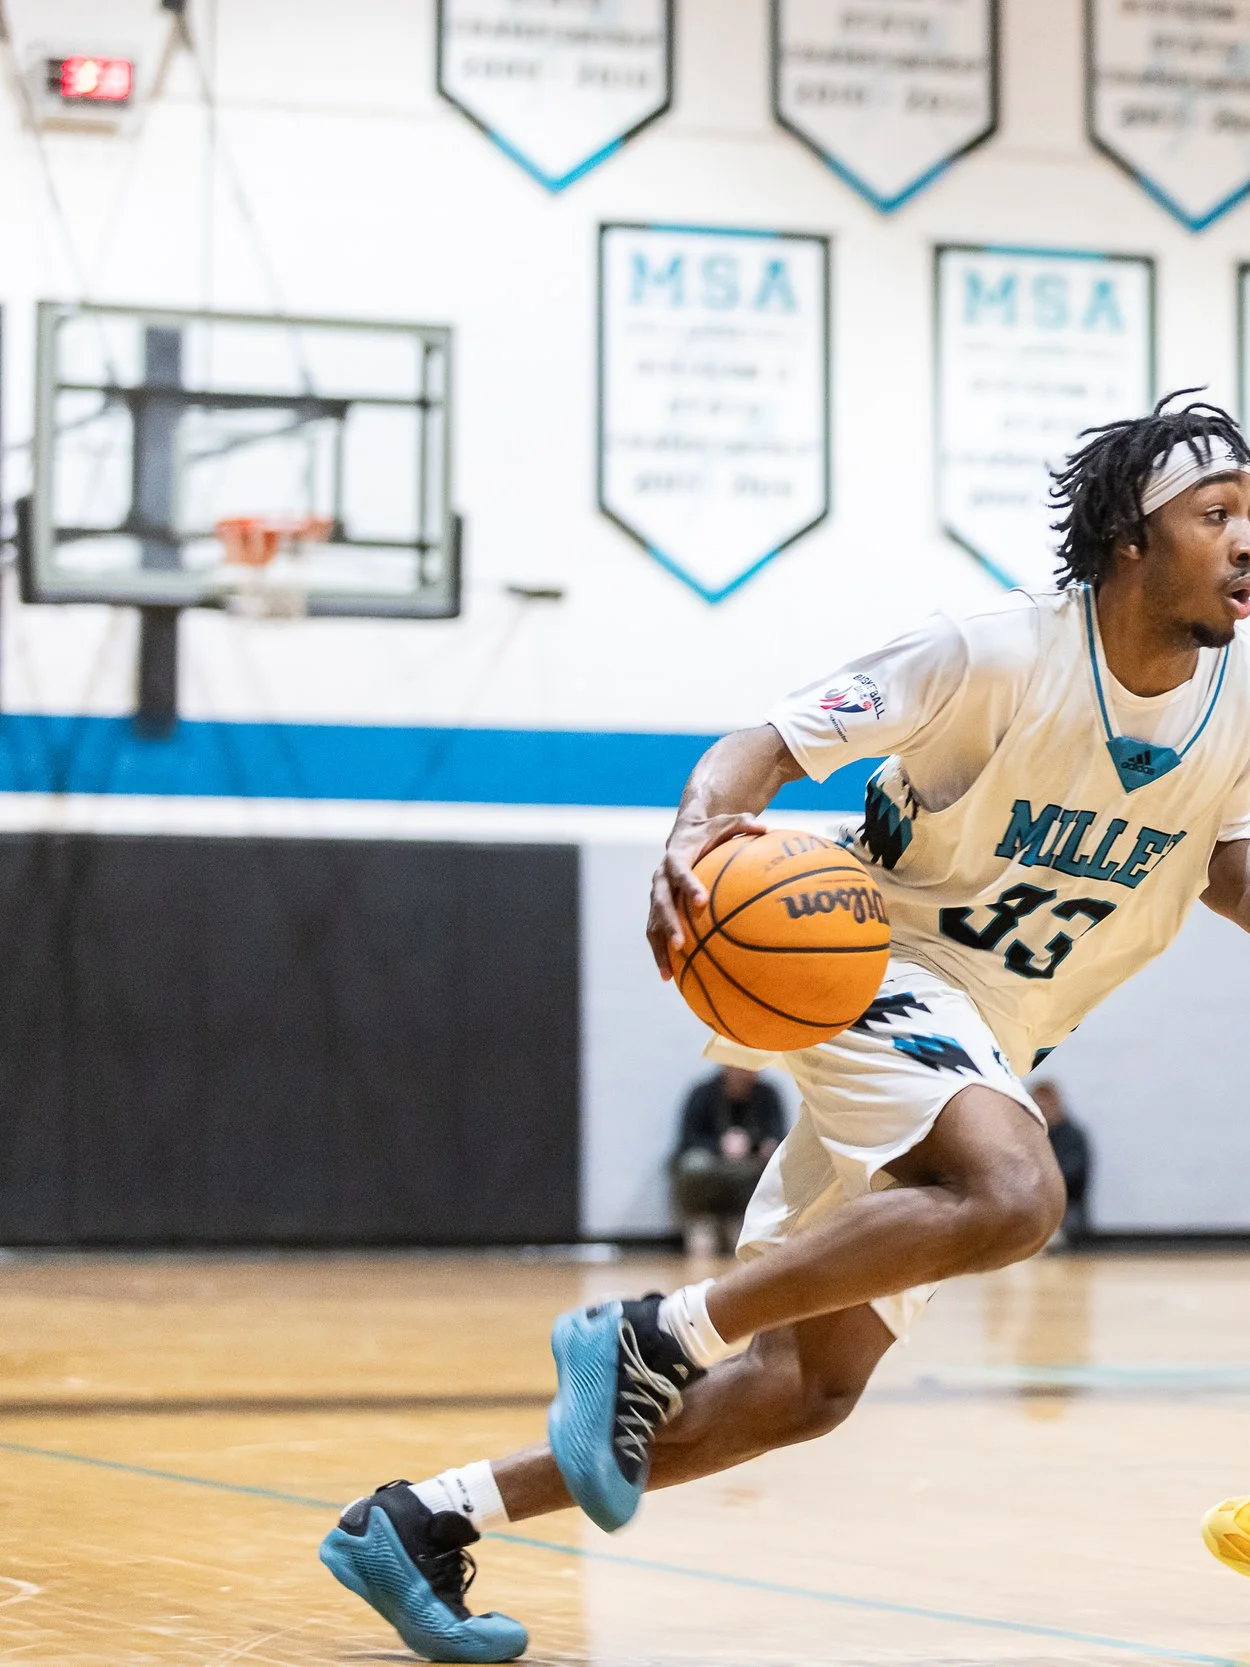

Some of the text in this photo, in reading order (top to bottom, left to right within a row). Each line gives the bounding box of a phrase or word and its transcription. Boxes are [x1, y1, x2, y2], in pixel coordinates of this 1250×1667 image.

[629, 251, 798, 313] MSA
[963, 271, 1125, 333] MSA
[1121, 761, 1157, 776] adidas
[939, 882, 1117, 979] 33
